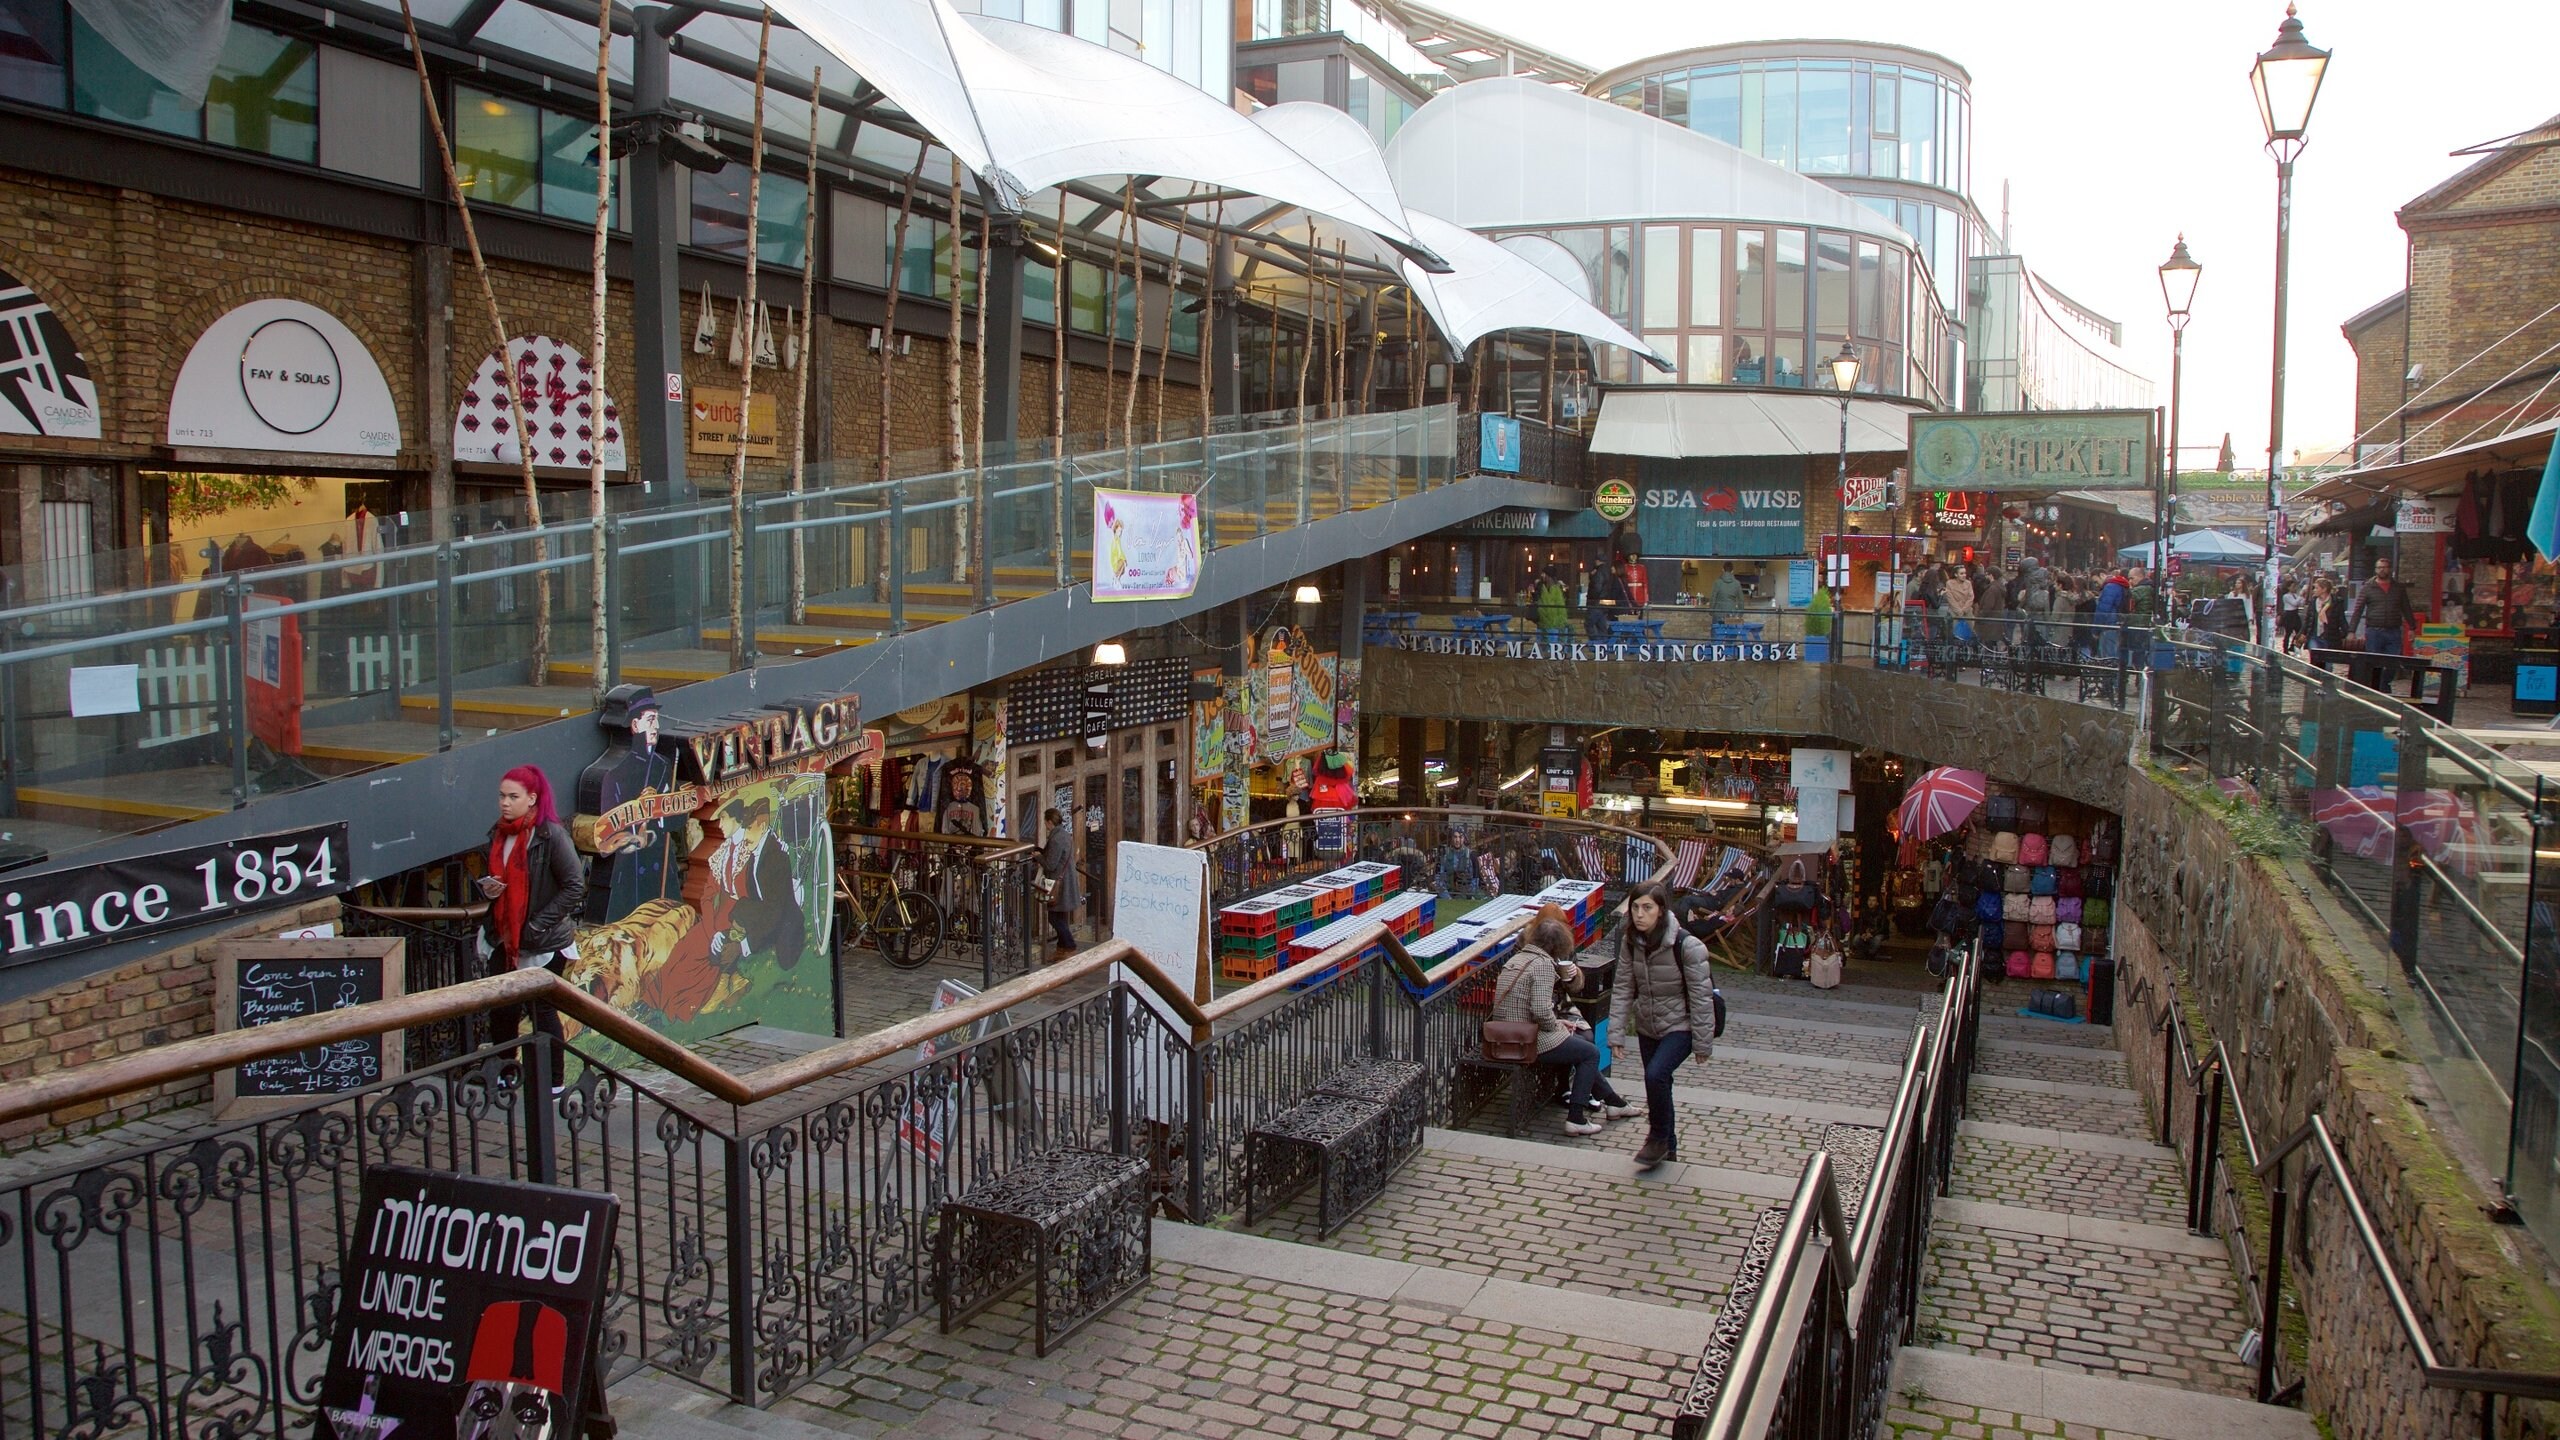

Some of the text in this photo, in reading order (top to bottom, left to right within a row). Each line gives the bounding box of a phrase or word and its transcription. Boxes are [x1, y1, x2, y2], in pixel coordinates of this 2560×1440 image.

[250, 368, 331, 386] FAY & SOLAS
[44, 405, 92, 419] CAMDEN
[175, 428, 214, 438] Unit 713
[359, 430, 394, 441] CAMDEN
[697, 432, 724, 443] STREET
[1979, 431, 2140, 478] MARKET
[1596, 495, 1633, 504] Heineken
[1644, 489, 1802, 509] SEA WISE
[1860, 492, 1882, 509] ROW
[2208, 493, 2246, 503] Stables
[1935, 510, 1977, 520] MEXICAN
[1938, 516, 1973, 527] FOODS
[1696, 520, 1710, 528] FISH
[1711, 520, 1717, 528] &
[1718, 520, 1736, 528] CHIPS
[1740, 520, 1766, 528] SEAFOOD
[1398, 634, 1799, 662] STABLES MARKET SINCE 1854
[1084, 668, 1114, 683] CEREAL
[1084, 697, 1114, 708] KILLER
[1086, 720, 1106, 733] CAFE
[689, 692, 863, 784] VINTAGE
[1546, 768, 1562, 776] UNIT
[608, 797, 655, 832] WHAT
[661, 790, 698, 815] GOES
[712, 770, 759, 796] AROUND
[824, 734, 870, 768] AROUND
[1123, 854, 1193, 892] Basement
[0, 836, 338, 954] ince 1854
[1119, 889, 1191, 921] Bookshop
[246, 963, 293, 984] Come
[298, 965, 337, 978] down
[255, 985, 284, 999] The
[243, 998, 305, 1018] Basement
[242, 1067, 265, 1077] Tea
[265, 1065, 279, 1078] for
[259, 1074, 362, 1092] Only £13.80
[368, 1187, 591, 1285] mirrormad
[359, 1268, 446, 1321] UNIQUE
[346, 1327, 455, 1384] MIRRORS
